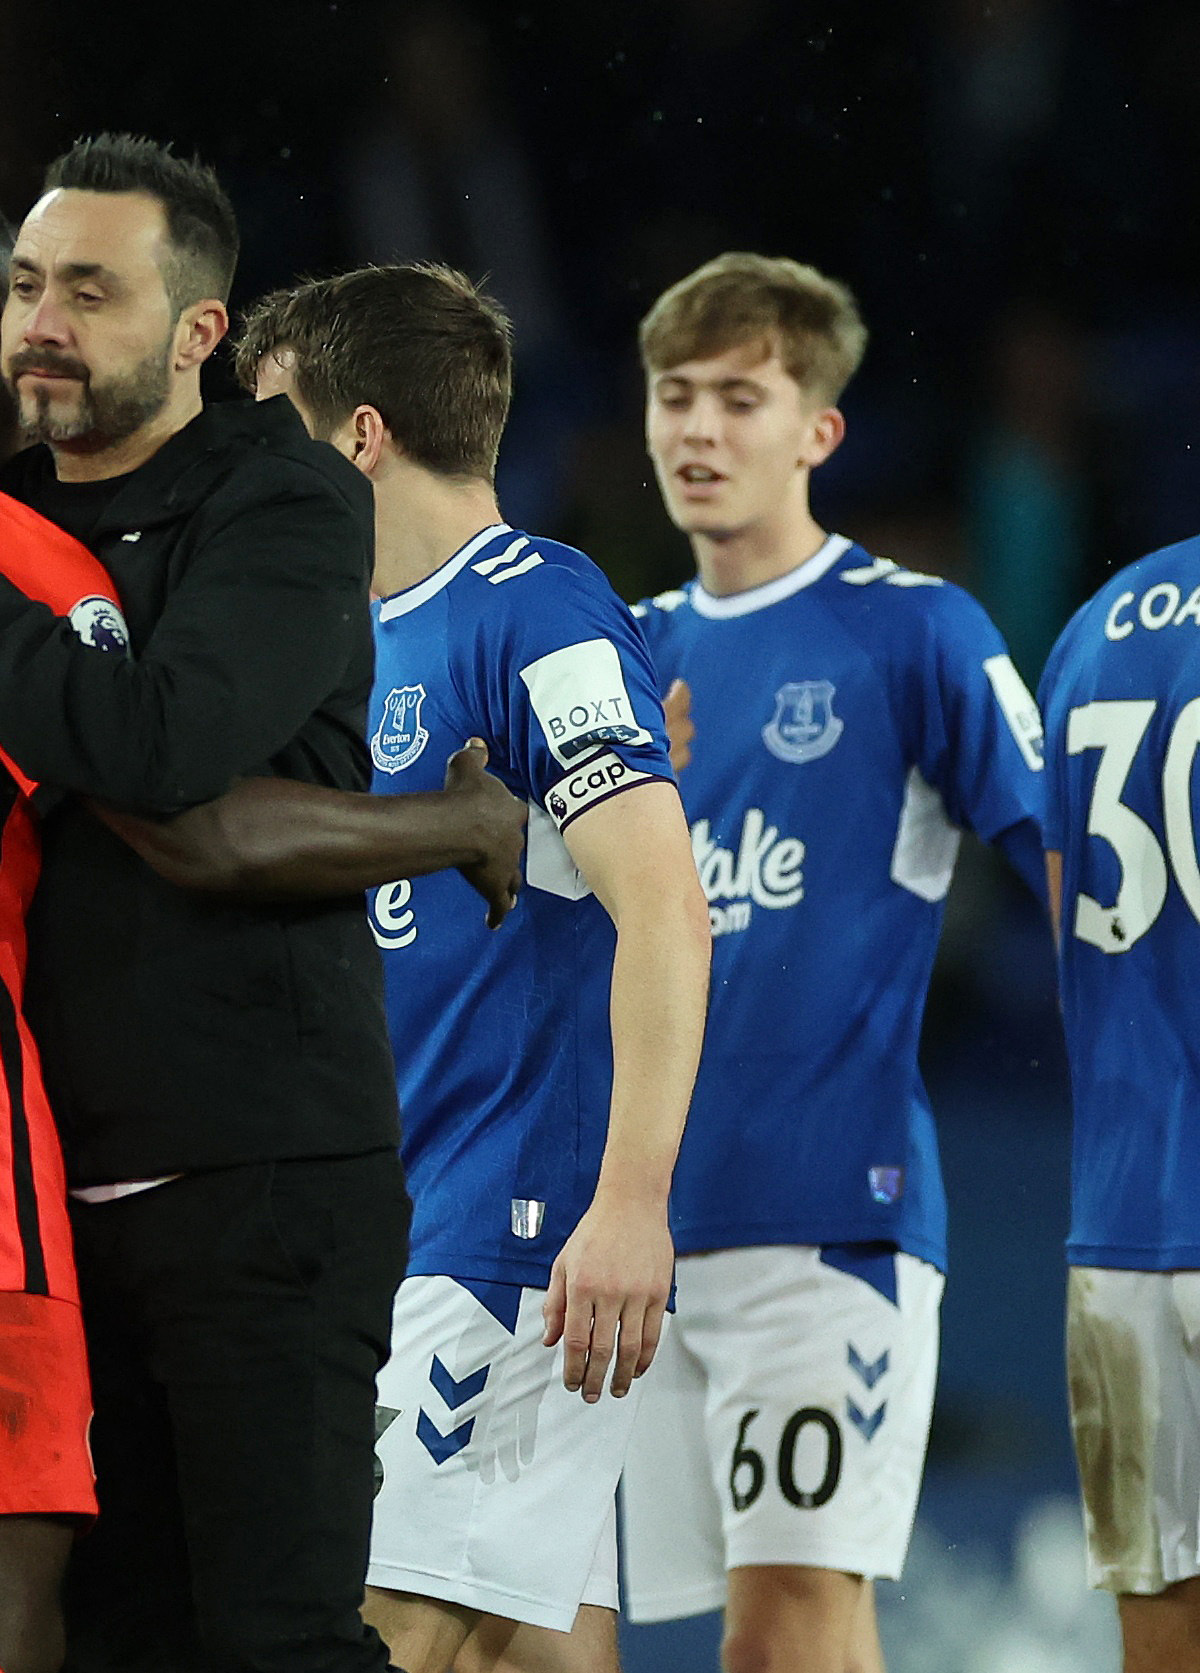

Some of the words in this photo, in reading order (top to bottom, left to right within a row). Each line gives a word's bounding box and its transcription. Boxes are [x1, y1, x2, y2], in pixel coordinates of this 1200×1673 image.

[548, 697, 622, 739] BOXT
[690, 807, 806, 909] take
[730, 1407, 843, 1512] 60
